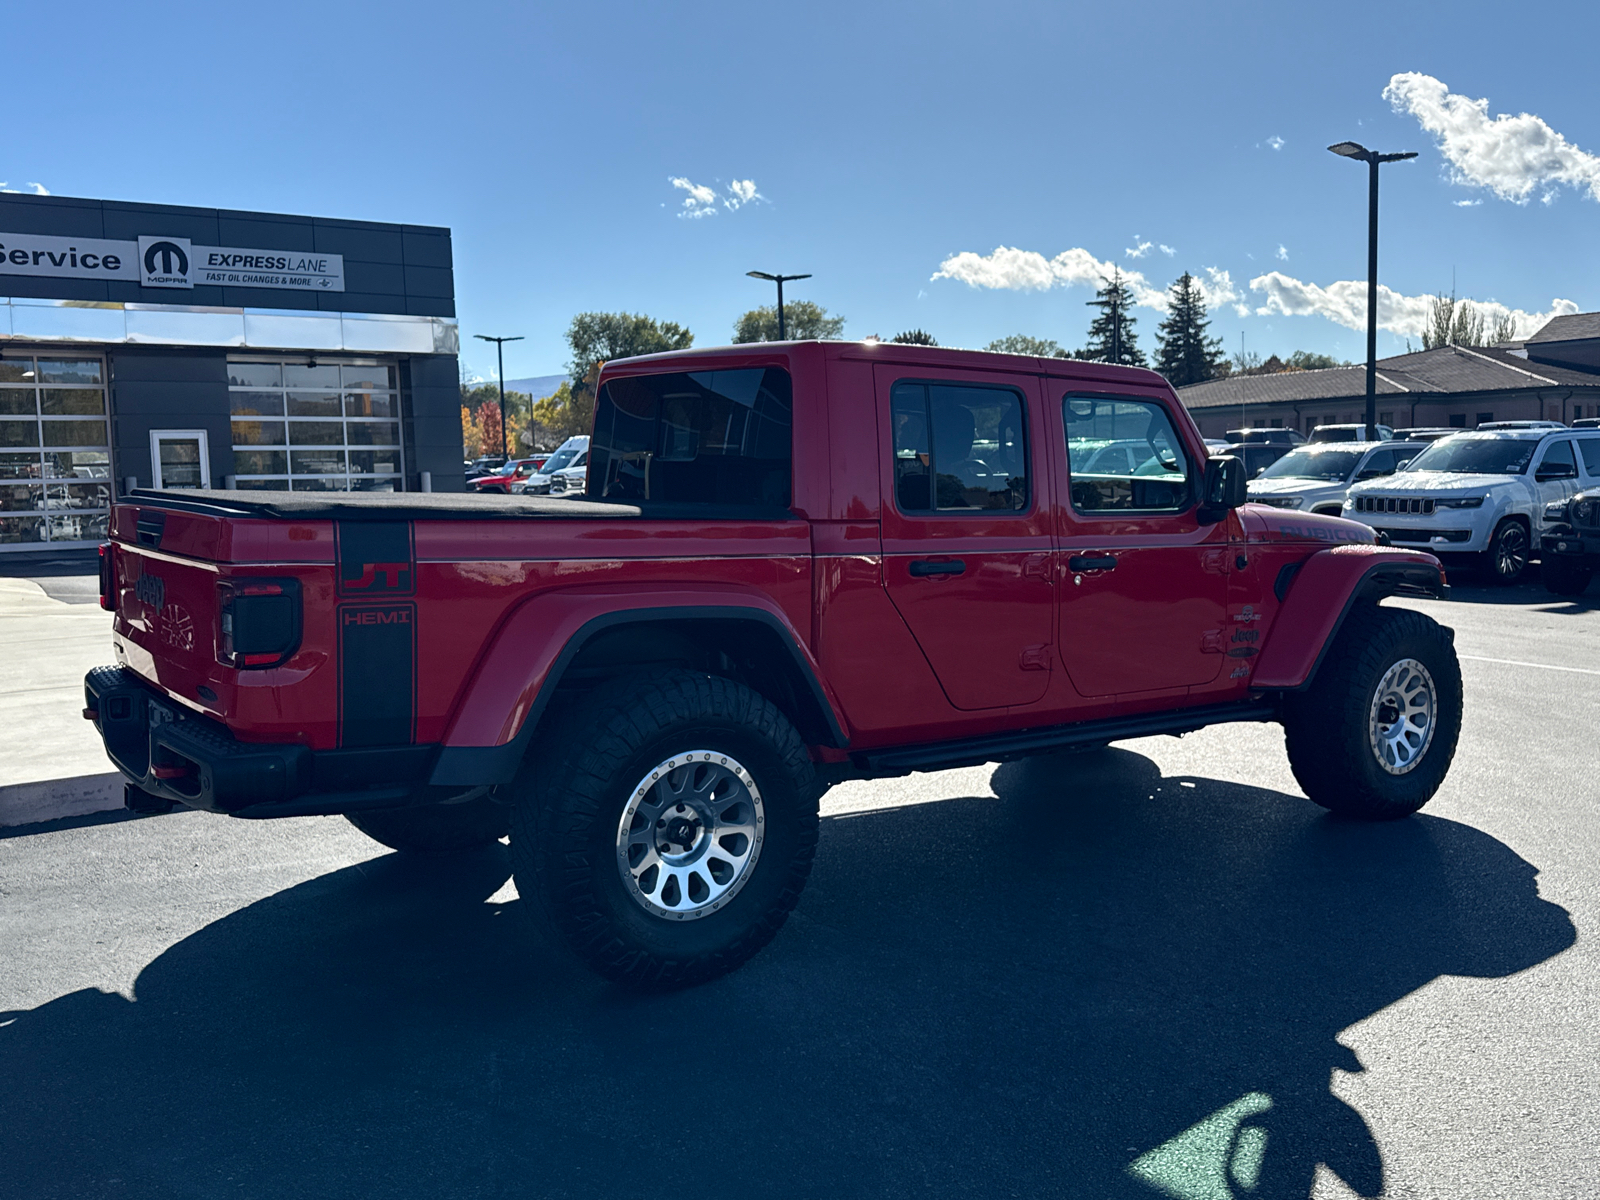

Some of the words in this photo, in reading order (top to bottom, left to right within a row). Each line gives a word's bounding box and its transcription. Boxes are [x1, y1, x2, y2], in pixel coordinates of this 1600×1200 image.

[206, 273, 226, 282] FAST
[228, 274, 241, 282] OIL
[242, 275, 279, 285] CHANGES
[281, 277, 287, 285] &
[289, 277, 311, 286] MORE
[1280, 526, 1372, 541] RUBICON
[344, 563, 409, 588] JT
[344, 611, 410, 625] HEMI
[1231, 628, 1259, 644] Jeep
